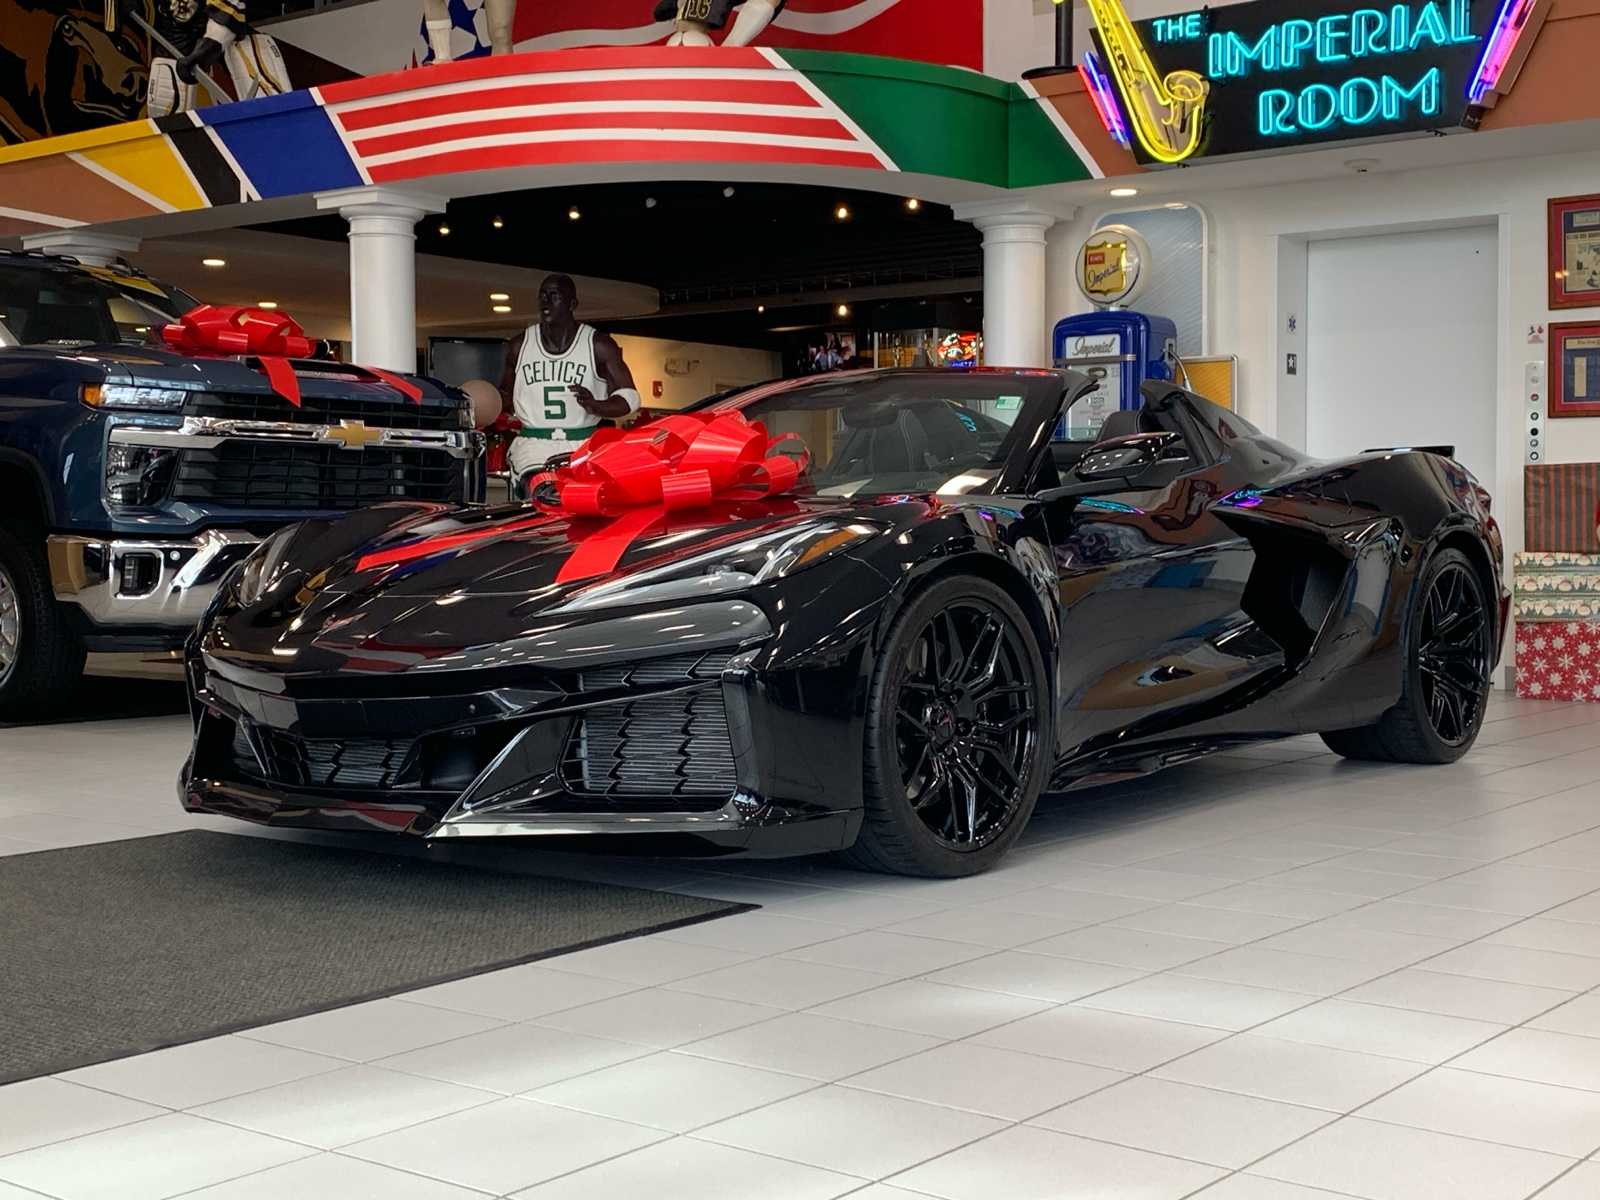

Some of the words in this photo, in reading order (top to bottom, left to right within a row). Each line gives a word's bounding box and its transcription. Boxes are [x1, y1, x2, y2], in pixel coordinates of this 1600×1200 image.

[1152, 13, 1201, 42] THE
[1208, 0, 1480, 77] IMPERIAL
[1259, 68, 1439, 136] ROOM
[1088, 257, 1120, 288] Imperial
[1072, 336, 1116, 358] Imperial
[522, 360, 587, 386] CELTICS
[543, 386, 567, 420] 5
